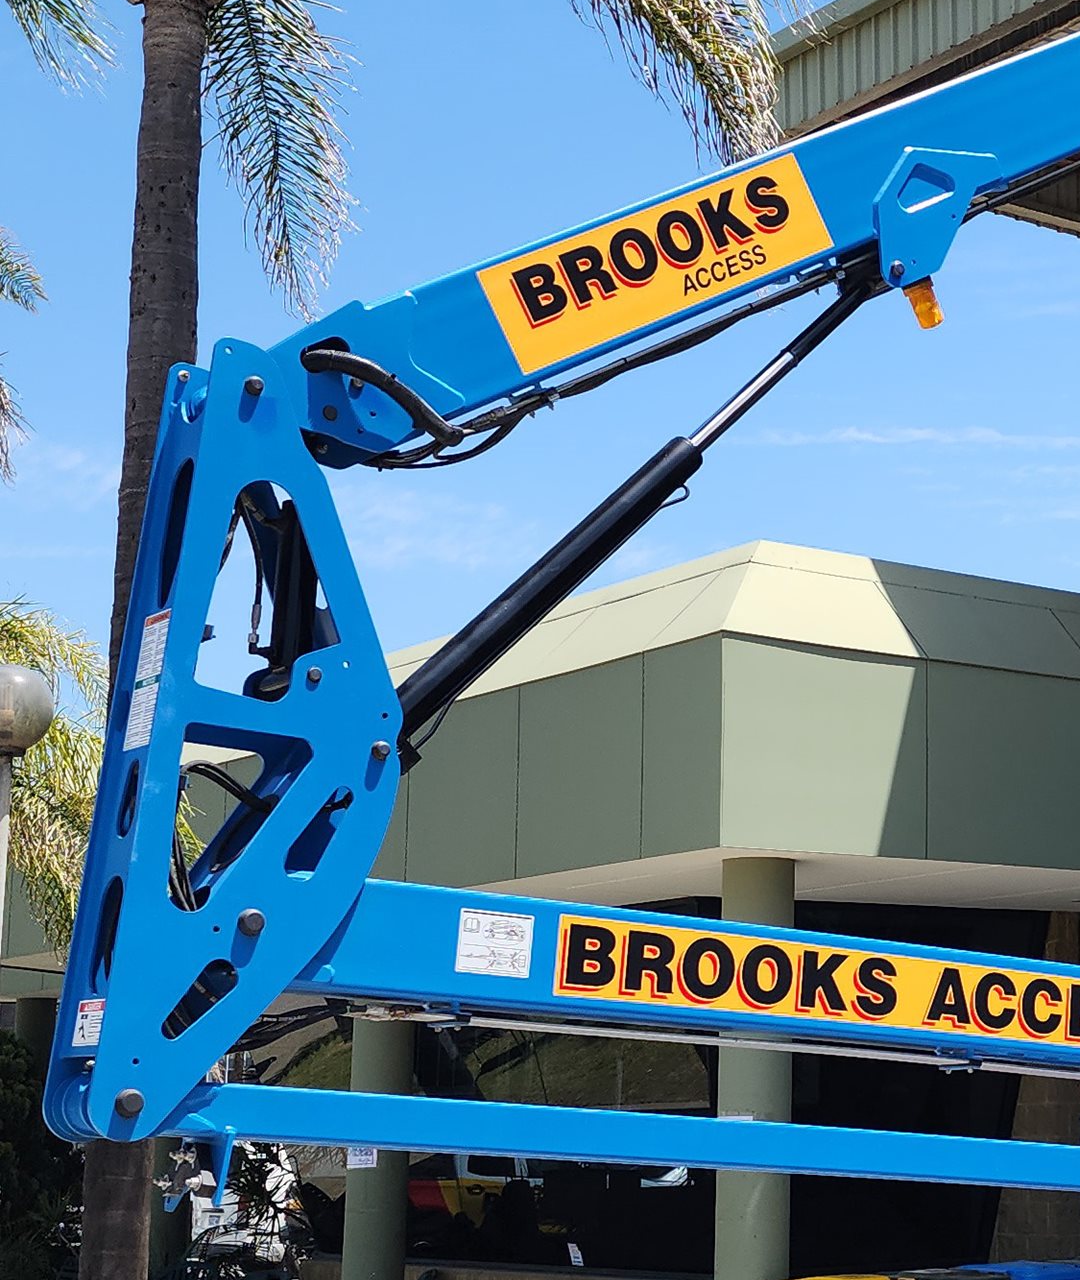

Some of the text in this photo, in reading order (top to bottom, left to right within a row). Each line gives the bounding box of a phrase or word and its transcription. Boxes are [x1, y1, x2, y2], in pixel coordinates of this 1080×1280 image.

[510, 176, 790, 329] BROOKS
[684, 245, 767, 296] ACCESS
[560, 923, 898, 1020] BROOKS
